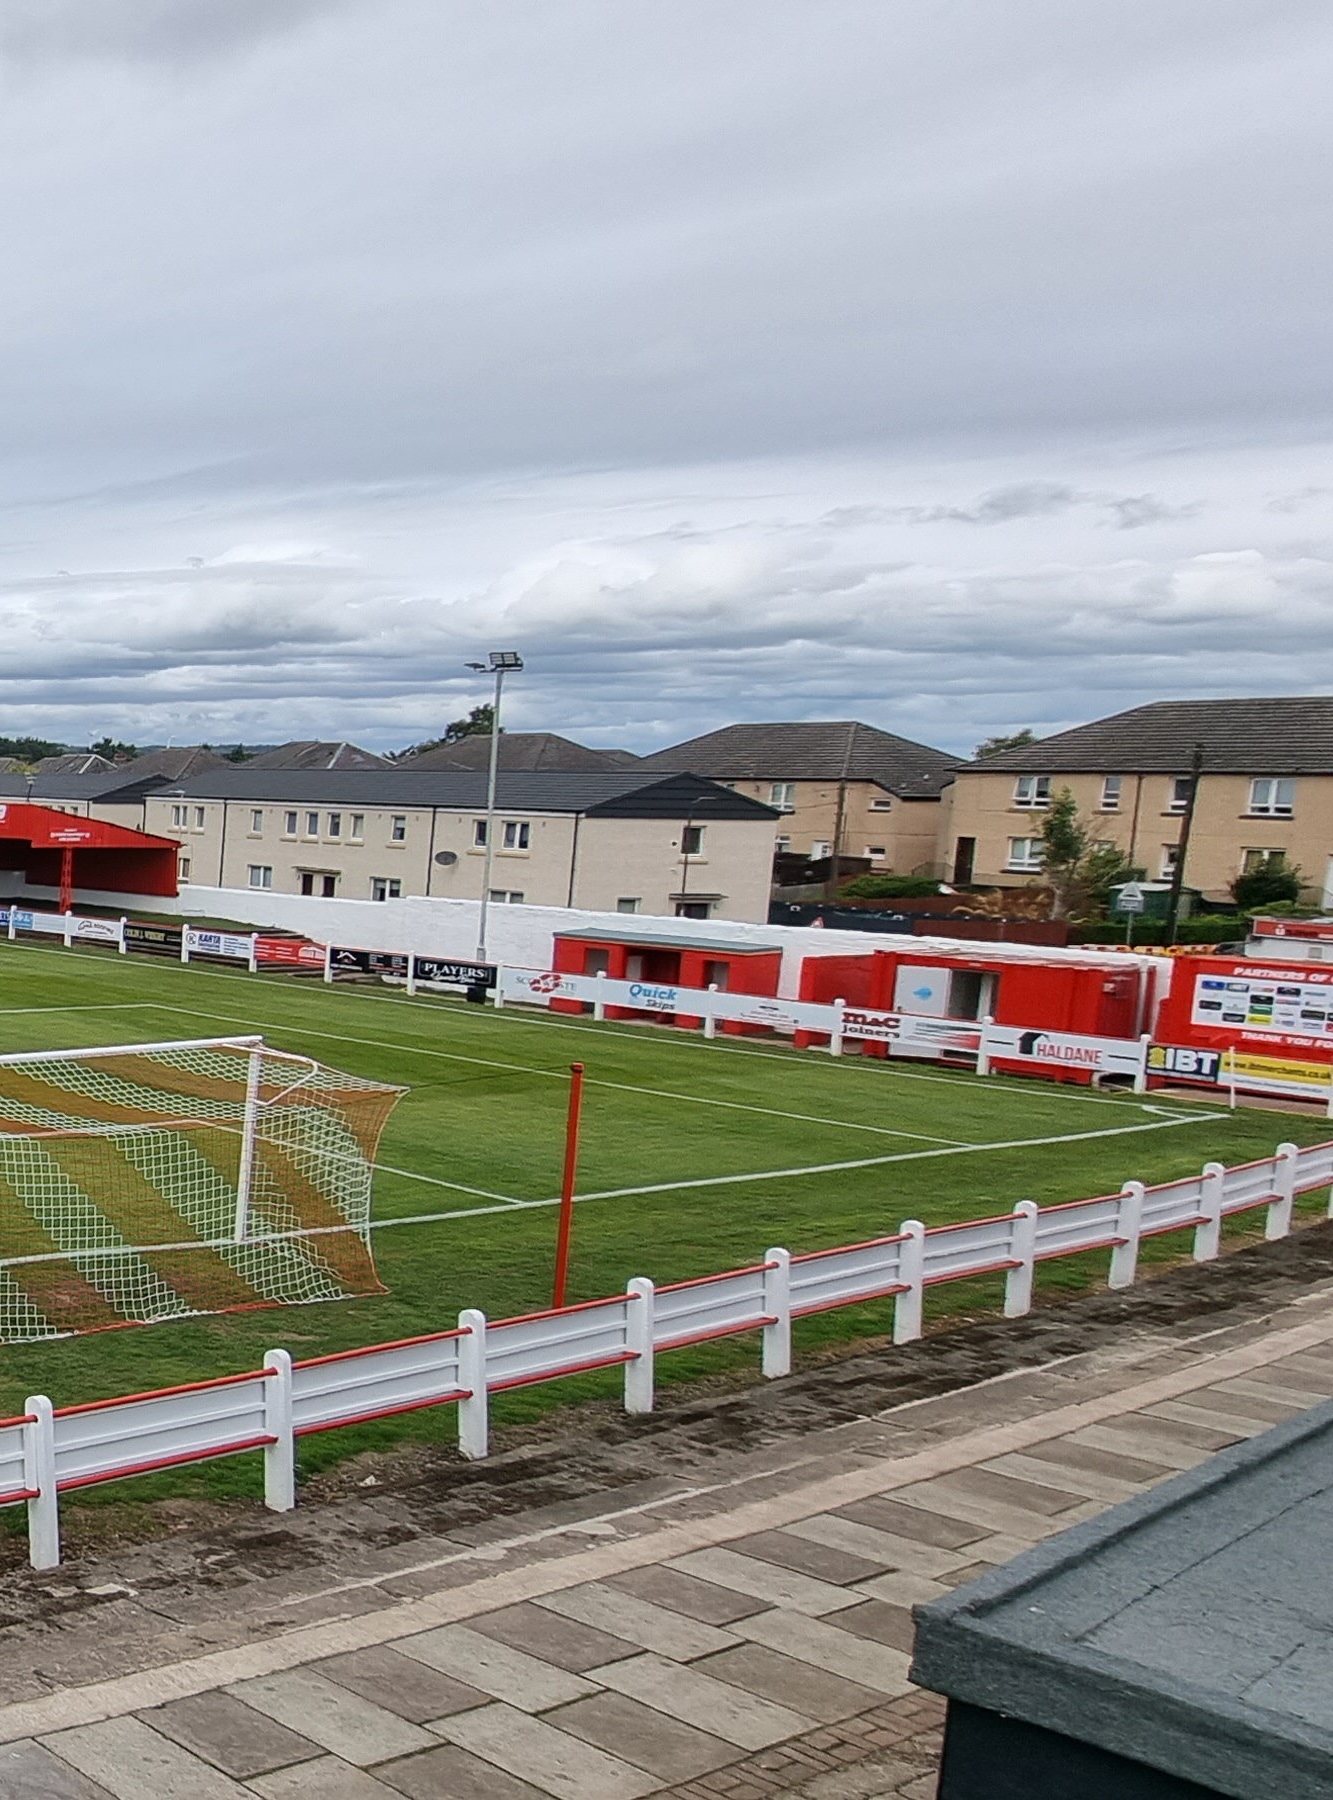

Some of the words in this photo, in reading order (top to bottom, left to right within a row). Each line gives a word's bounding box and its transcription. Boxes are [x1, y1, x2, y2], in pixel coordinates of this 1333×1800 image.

[424, 963, 485, 978] PLAYERS
[1233, 967, 1306, 980] PARTNERS
[629, 984, 678, 1001] Quick
[646, 999, 675, 1011] Skips
[1241, 1031, 1282, 1043] THANK
[1286, 1036, 1314, 1046] YOU
[1037, 1043, 1103, 1064] HALDANE
[1165, 1048, 1218, 1075] IBT
